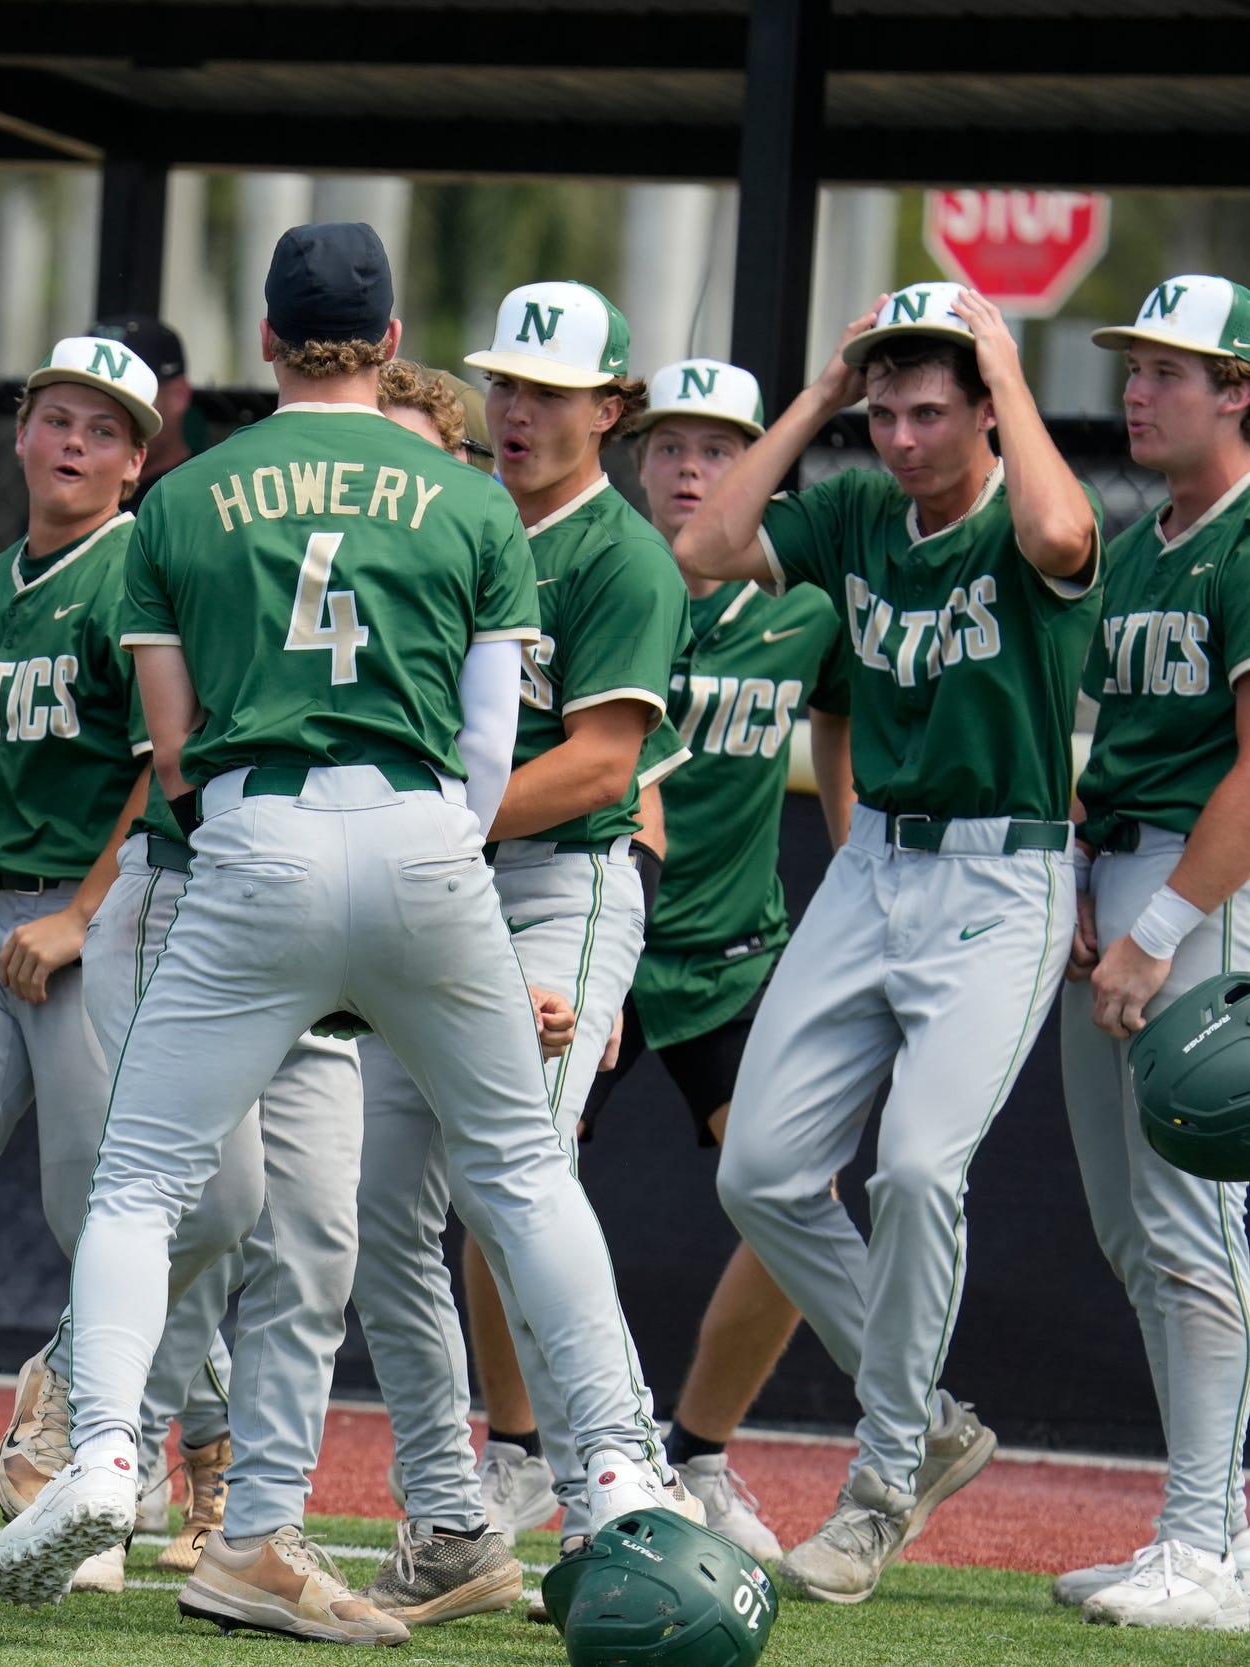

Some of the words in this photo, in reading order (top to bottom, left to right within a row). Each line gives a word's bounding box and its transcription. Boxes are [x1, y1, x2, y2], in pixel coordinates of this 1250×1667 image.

[888, 292, 931, 325] N
[1143, 286, 1187, 319] N
[516, 301, 564, 345] N
[88, 344, 131, 381] N
[679, 368, 719, 399] N
[211, 461, 443, 532] HOWERY
[283, 532, 369, 686] 4
[733, 1584, 762, 1630] 10
